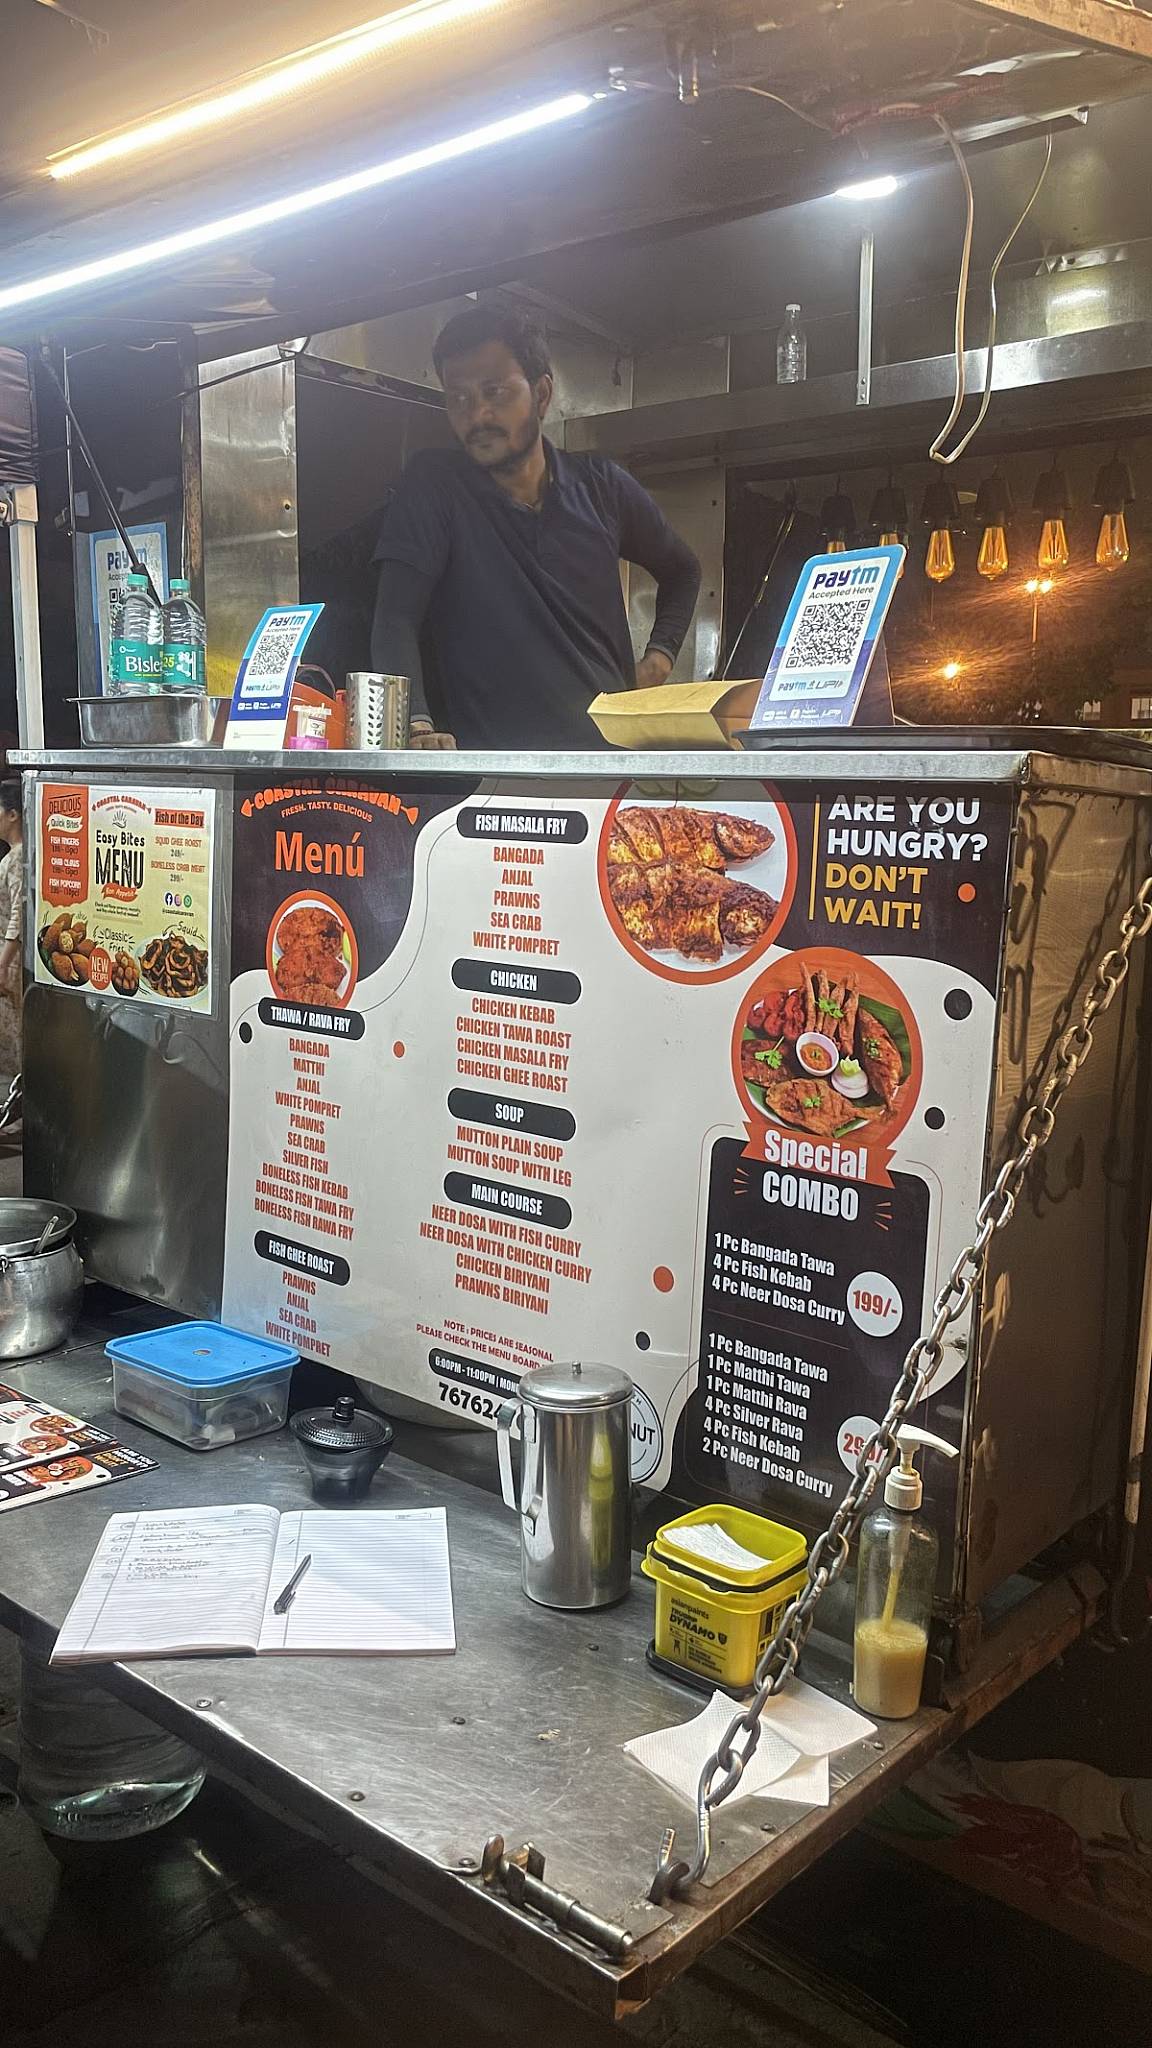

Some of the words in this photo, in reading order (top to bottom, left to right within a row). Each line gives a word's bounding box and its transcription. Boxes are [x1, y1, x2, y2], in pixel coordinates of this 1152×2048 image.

[808, 587, 851, 600] Accepted
[852, 586, 874, 594] Here
[49, 797, 81, 814] DELICIOUS
[156, 811, 169, 822] Fish
[170, 813, 177, 823] of
[178, 814, 189, 824] the
[191, 814, 204, 827] Day
[281, 806, 306, 818] FRESH.
[308, 802, 331, 810] TASTY.
[333, 802, 373, 823] DELICIOUS
[828, 795, 896, 822] ARE
[906, 796, 980, 825] YOU
[51, 819, 65, 828] Quick
[66, 820, 79, 829] Bites
[96, 830, 118, 848] Easy
[121, 832, 144, 846] Bites
[475, 814, 499, 831] FISH
[501, 816, 545, 834] MASALA
[546, 818, 568, 835] FRY
[275, 831, 364, 877] Menú
[494, 847, 544, 864] BANGADA
[827, 828, 988, 861] HUNGRY?
[96, 847, 144, 889] MENU
[502, 869, 533, 886] ANJAL
[826, 863, 928, 894] DON'T
[494, 890, 540, 909] PRAWNS
[824, 896, 922, 930] WAIT!
[105, 928, 128, 942] Classic
[177, 921, 197, 937] Squid
[491, 912, 510, 928] SEA
[512, 915, 542, 931] CRAB
[473, 931, 506, 949] WHITE
[508, 936, 559, 956] POMPRET
[91, 956, 109, 972] NEW
[490, 970, 537, 991] CHICKEN
[271, 1006, 301, 1024] THAWA
[309, 1013, 333, 1029] RAVA
[333, 1017, 351, 1033] FRY
[472, 997, 517, 1019] CHICKEN
[519, 1004, 555, 1024] KEBAB
[457, 1016, 500, 1038] CHICKEN
[503, 1024, 533, 1043] TAWA
[535, 1028, 572, 1049] ROAST
[289, 1038, 330, 1058] BANGADA
[457, 1037, 500, 1060] CHICKEN
[503, 1045, 547, 1067] MASALA
[549, 1056, 569, 1071] FRY
[293, 1057, 325, 1076] MATTHI
[457, 1058, 500, 1081] CHICKEN
[503, 1067, 530, 1086] GHEE
[532, 1072, 568, 1092] ROAST
[296, 1077, 320, 1094] ANJAL
[275, 1091, 302, 1109] WHITE
[303, 1097, 341, 1119] POMPRET
[495, 1103, 524, 1123] SOUP
[290, 1113, 325, 1134] PRAWNS
[288, 1132, 302, 1147] SEA
[304, 1135, 325, 1154] CRAB
[457, 1125, 499, 1148] MUTTON
[502, 1135, 532, 1156] PLAIN
[534, 1143, 563, 1162] SOUP
[764, 1130, 868, 1180] Special
[283, 1150, 309, 1169] SILVER
[311, 1157, 328, 1174] FISH
[447, 1144, 489, 1167] MUTTON
[492, 1156, 520, 1174] SOUP
[521, 1162, 550, 1182] WITH
[552, 1170, 572, 1187] LEG
[262, 1162, 301, 1185] BONELESS
[302, 1174, 320, 1192] FISH
[321, 1179, 348, 1200] KEBAB
[762, 1171, 859, 1221] COMBO
[256, 1180, 294, 1203] BONELESS
[295, 1191, 312, 1209] FISH
[315, 1197, 337, 1216] TAWA
[338, 1206, 354, 1221] FRY
[471, 1184, 499, 1204] MAIN
[501, 1191, 543, 1216] COURSE
[254, 1197, 292, 1221] BONELESS
[294, 1209, 311, 1228] FISH
[312, 1217, 337, 1237] RAWA
[338, 1224, 354, 1241] FRY
[432, 1204, 457, 1224] NEER
[459, 1211, 486, 1232] DOSA
[488, 1218, 516, 1240] WITH
[519, 1227, 542, 1247] FISH
[545, 1234, 581, 1258] CURRY
[269, 1239, 286, 1259] FISH
[287, 1247, 306, 1265] GHEE
[307, 1255, 334, 1275] ROAST
[420, 1222, 444, 1242] NEER
[446, 1229, 474, 1250] DOSA
[476, 1236, 505, 1258] WITH
[507, 1245, 553, 1273] CHICKEN
[555, 1259, 592, 1284] CURRY
[714, 1232, 721, 1248] 1
[723, 1233, 739, 1253] Pc
[741, 1238, 798, 1267] Bangada
[801, 1252, 835, 1276] Tawa
[282, 1271, 316, 1295] PRAWNS
[456, 1253, 501, 1279] CHICKEN
[504, 1266, 550, 1293] BIRIYANI
[713, 1254, 722, 1268] 4
[724, 1256, 740, 1273] Pc
[741, 1261, 767, 1281] Fish
[770, 1267, 812, 1292] Kebab
[455, 1273, 500, 1299] PRAWNS
[502, 1286, 549, 1315] BIRIYANI
[712, 1275, 720, 1291] 4
[722, 1276, 738, 1294] Pc
[740, 1281, 771, 1303] Neer
[772, 1291, 805, 1313] Dosa
[807, 1299, 846, 1326] Curry
[853, 1289, 898, 1318] 199/-
[279, 1308, 294, 1324] SEA
[295, 1315, 317, 1333] CRAB
[266, 1320, 291, 1342] WHITE
[292, 1331, 331, 1357] POMPRET
[416, 1324, 442, 1339] PLEASE
[444, 1333, 469, 1347] CHECK
[471, 1340, 486, 1352] THE
[488, 1347, 510, 1360] MENU
[444, 1320, 465, 1332] NOTE
[471, 1328, 496, 1342] PRICES
[498, 1336, 513, 1347] ARE
[515, 1341, 553, 1362] SEASONAL
[709, 1333, 715, 1348] 1
[717, 1334, 733, 1353] Pc
[735, 1339, 791, 1371] Bangada
[794, 1356, 828, 1383] Tawa
[707, 1354, 713, 1369] 1
[716, 1355, 731, 1374] Pc
[734, 1360, 775, 1385] Matthi
[777, 1373, 810, 1399] Tawa
[702, 1437, 710, 1453] 2
[712, 1439, 728, 1459] Pc
[730, 1446, 760, 1470] Neer
[761, 1456, 794, 1483] Dosa
[795, 1469, 834, 1499] Curry
[670, 1614, 715, 1640] DYNAMO
